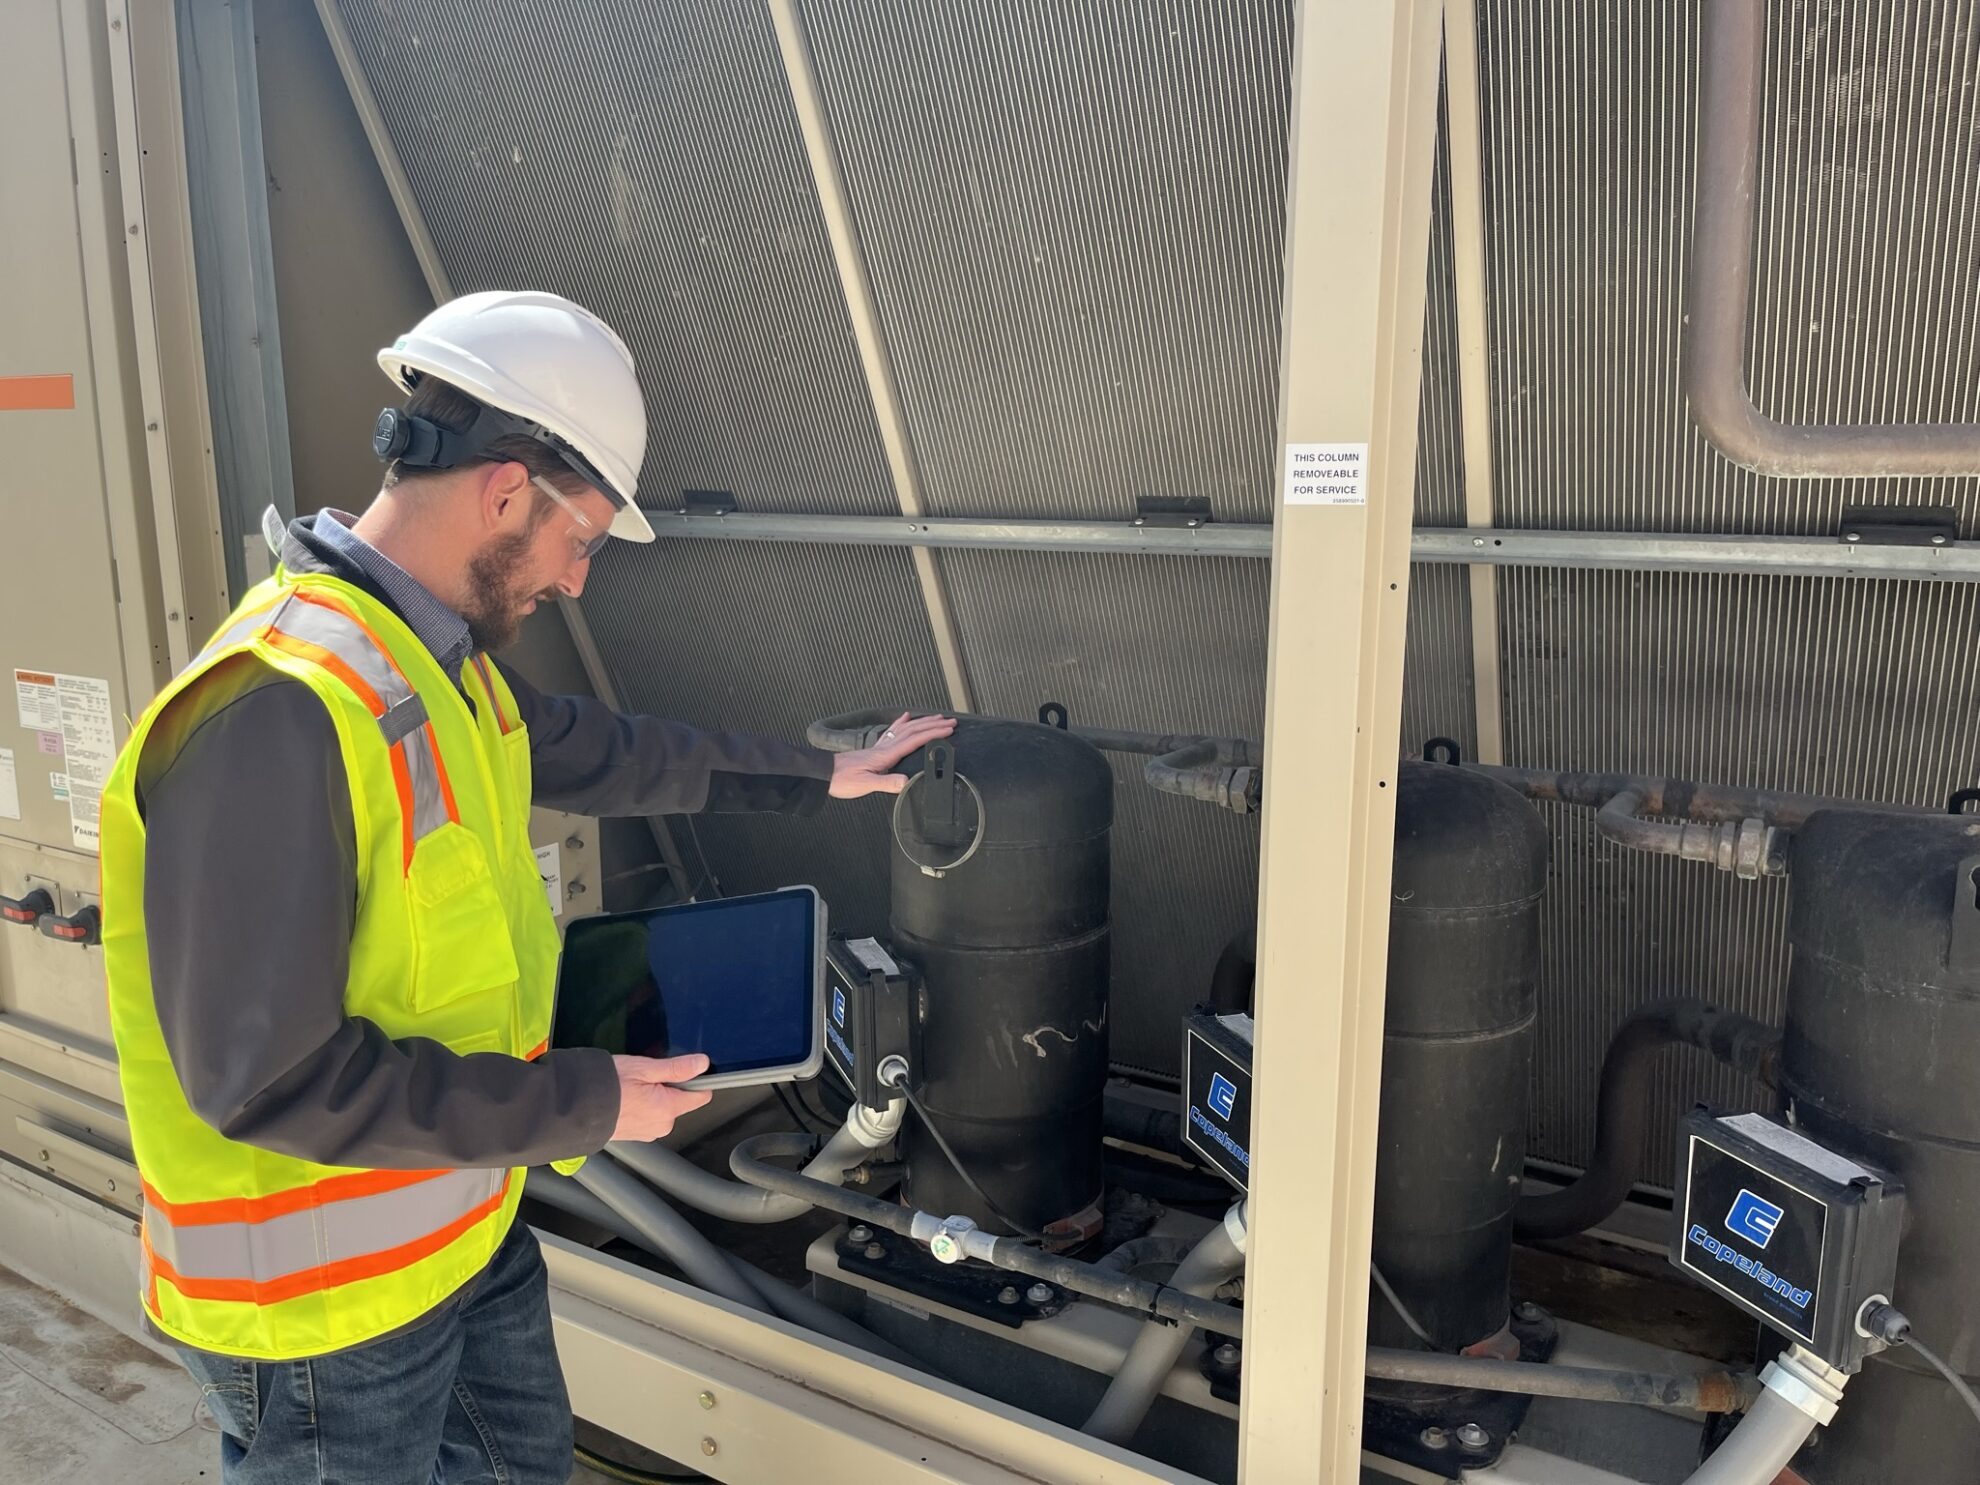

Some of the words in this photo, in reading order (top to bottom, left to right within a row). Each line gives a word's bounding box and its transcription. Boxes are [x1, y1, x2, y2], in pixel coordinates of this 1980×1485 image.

[1294, 453, 1315, 462] THIS
[1317, 453, 1359, 462] COLUMN
[1293, 469, 1359, 478] REMOVEABLE
[1293, 486, 1313, 494] FOR
[1316, 485, 1357, 494] SERVICE
[1688, 1224, 1812, 1309] Copeland
